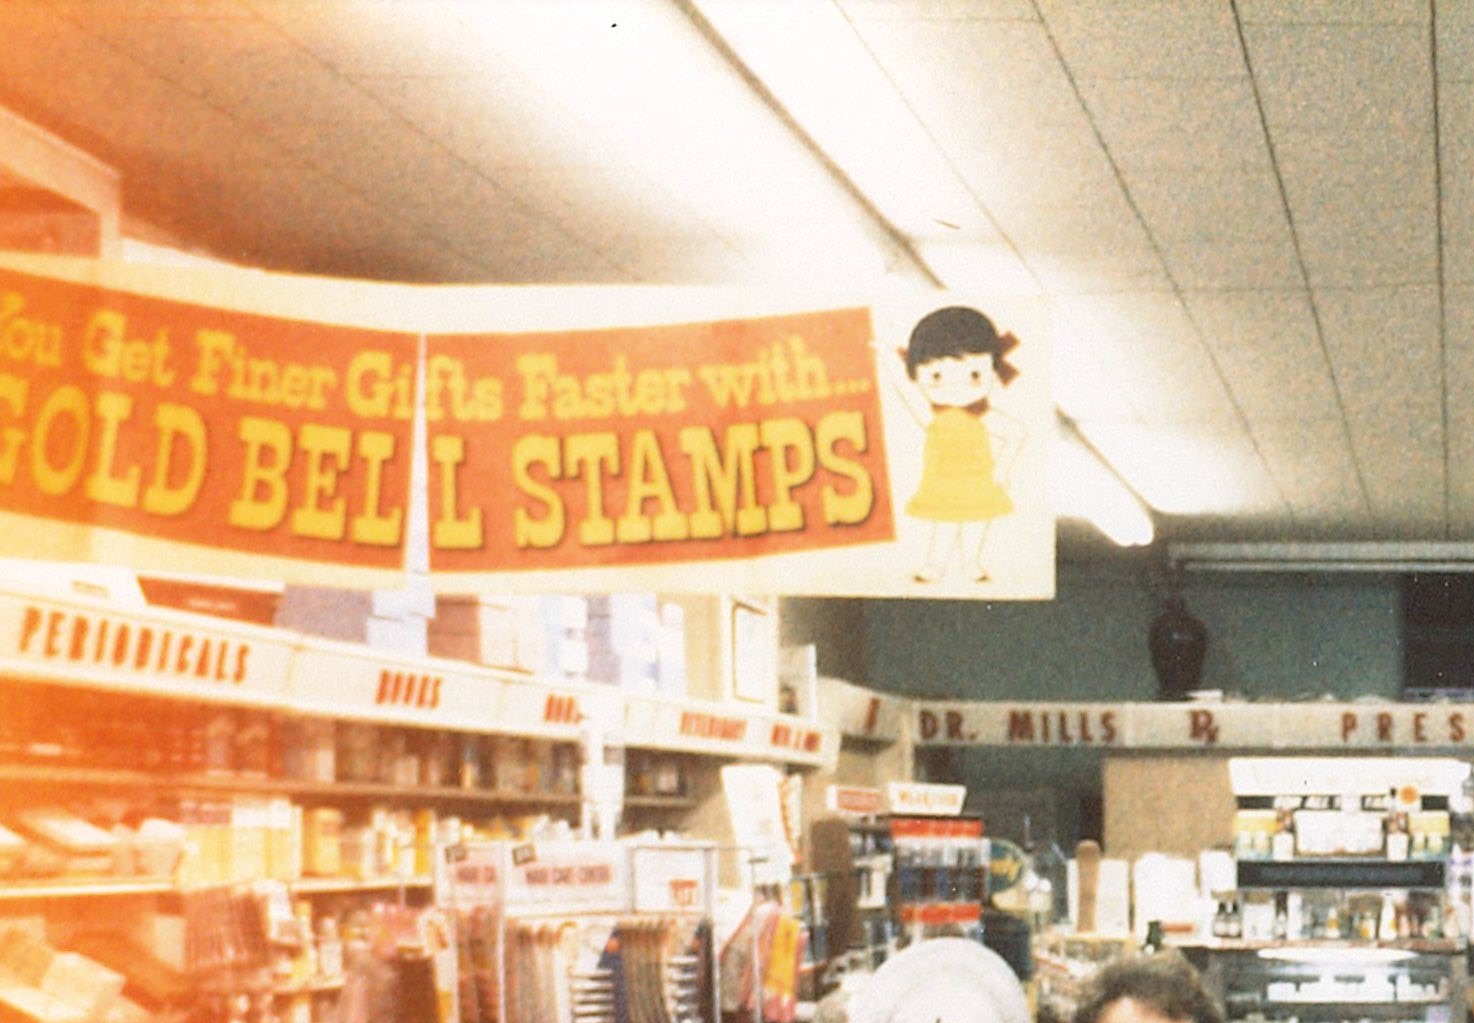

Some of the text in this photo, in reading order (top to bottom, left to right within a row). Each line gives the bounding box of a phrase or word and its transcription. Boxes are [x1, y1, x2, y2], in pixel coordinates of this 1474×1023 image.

[83, 308, 175, 388] Get
[192, 328, 337, 411] Finer
[345, 348, 503, 422] Gifts
[515, 352, 692, 422] Faster
[228, 416, 484, 551] BELL
[512, 408, 877, 549] STAMPS
[19, 606, 250, 684] PERIODICALS
[918, 709, 978, 742] DR.
[1008, 709, 1118, 744] MILLS
